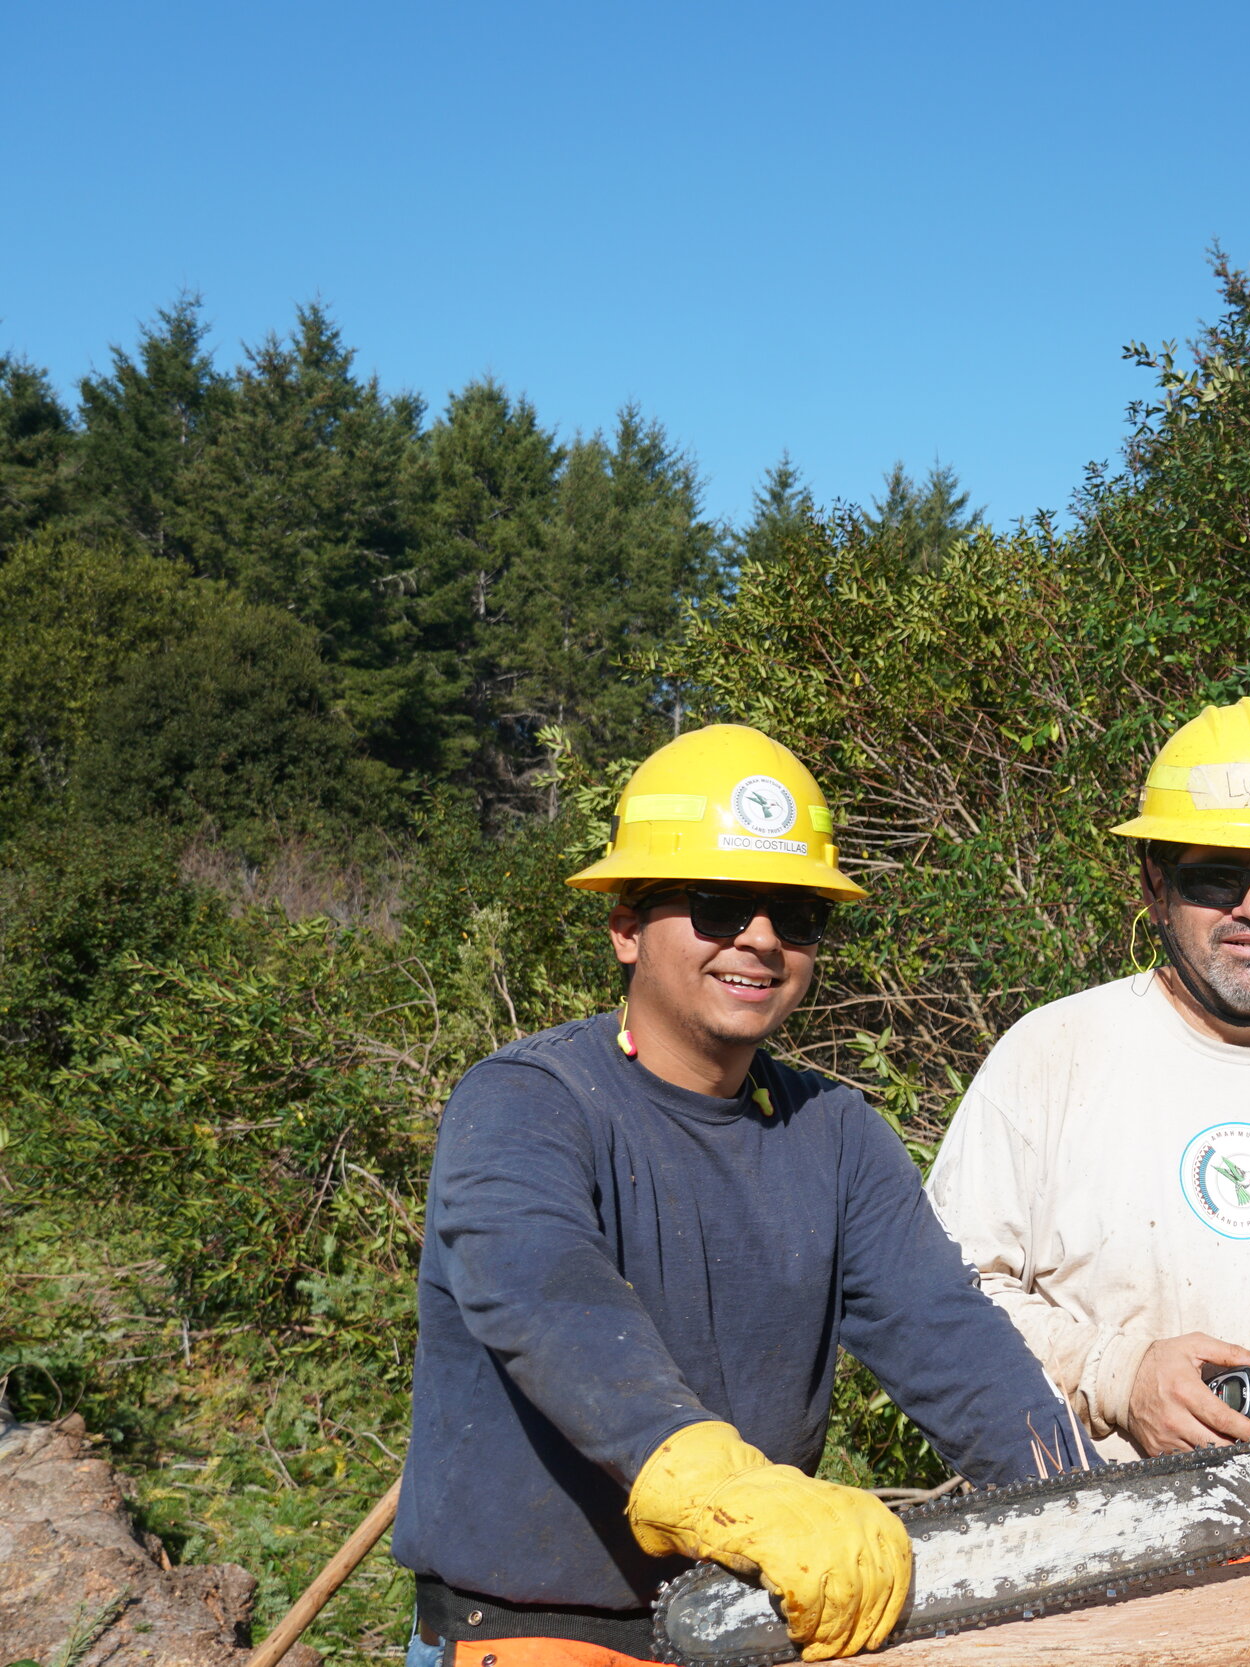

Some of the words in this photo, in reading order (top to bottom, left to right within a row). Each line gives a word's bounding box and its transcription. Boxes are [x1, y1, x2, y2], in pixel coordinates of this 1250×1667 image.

[722, 836, 751, 848] NICO
[754, 839, 807, 854] COSTILLAS
[1211, 1131, 1235, 1142] AMAH
[1216, 1213, 1238, 1228] LAND
